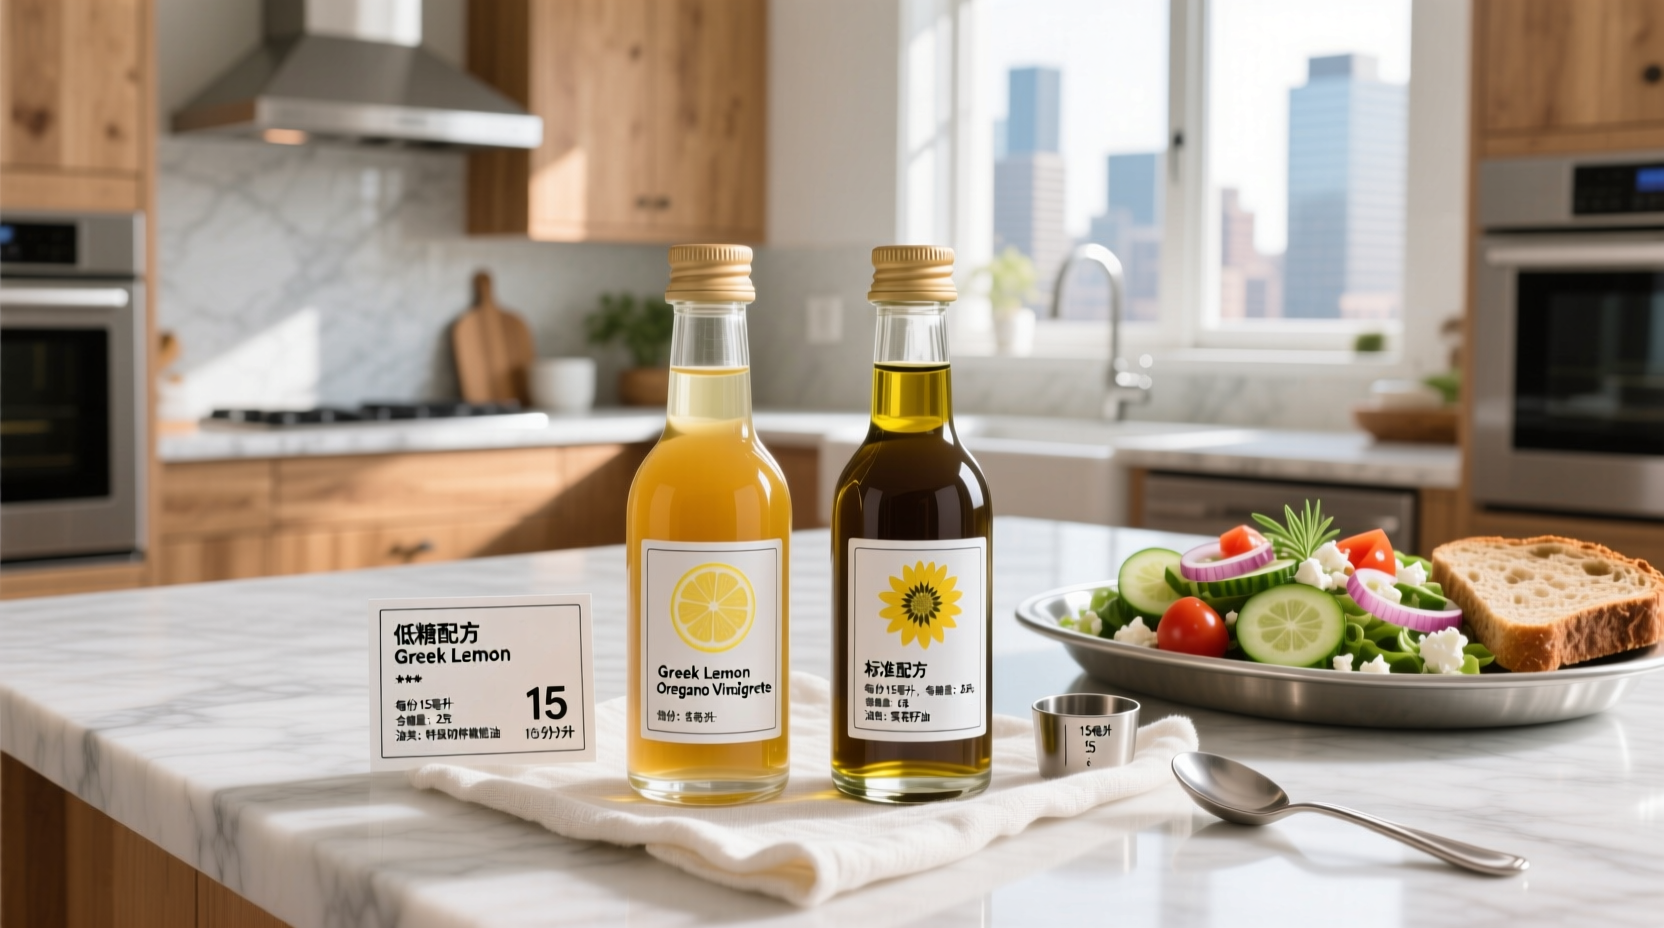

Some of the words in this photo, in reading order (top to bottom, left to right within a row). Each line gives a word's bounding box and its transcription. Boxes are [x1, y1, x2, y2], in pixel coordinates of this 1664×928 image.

[394, 621, 480, 646] 低糖配方
[394, 647, 447, 665] Greek
[451, 647, 511, 663] Lemon
[657, 664, 700, 680] Greek
[704, 666, 751, 680] Lemon
[864, 659, 928, 679] 标准配方
[656, 681, 710, 700] Oregano
[526, 685, 568, 720] 15
